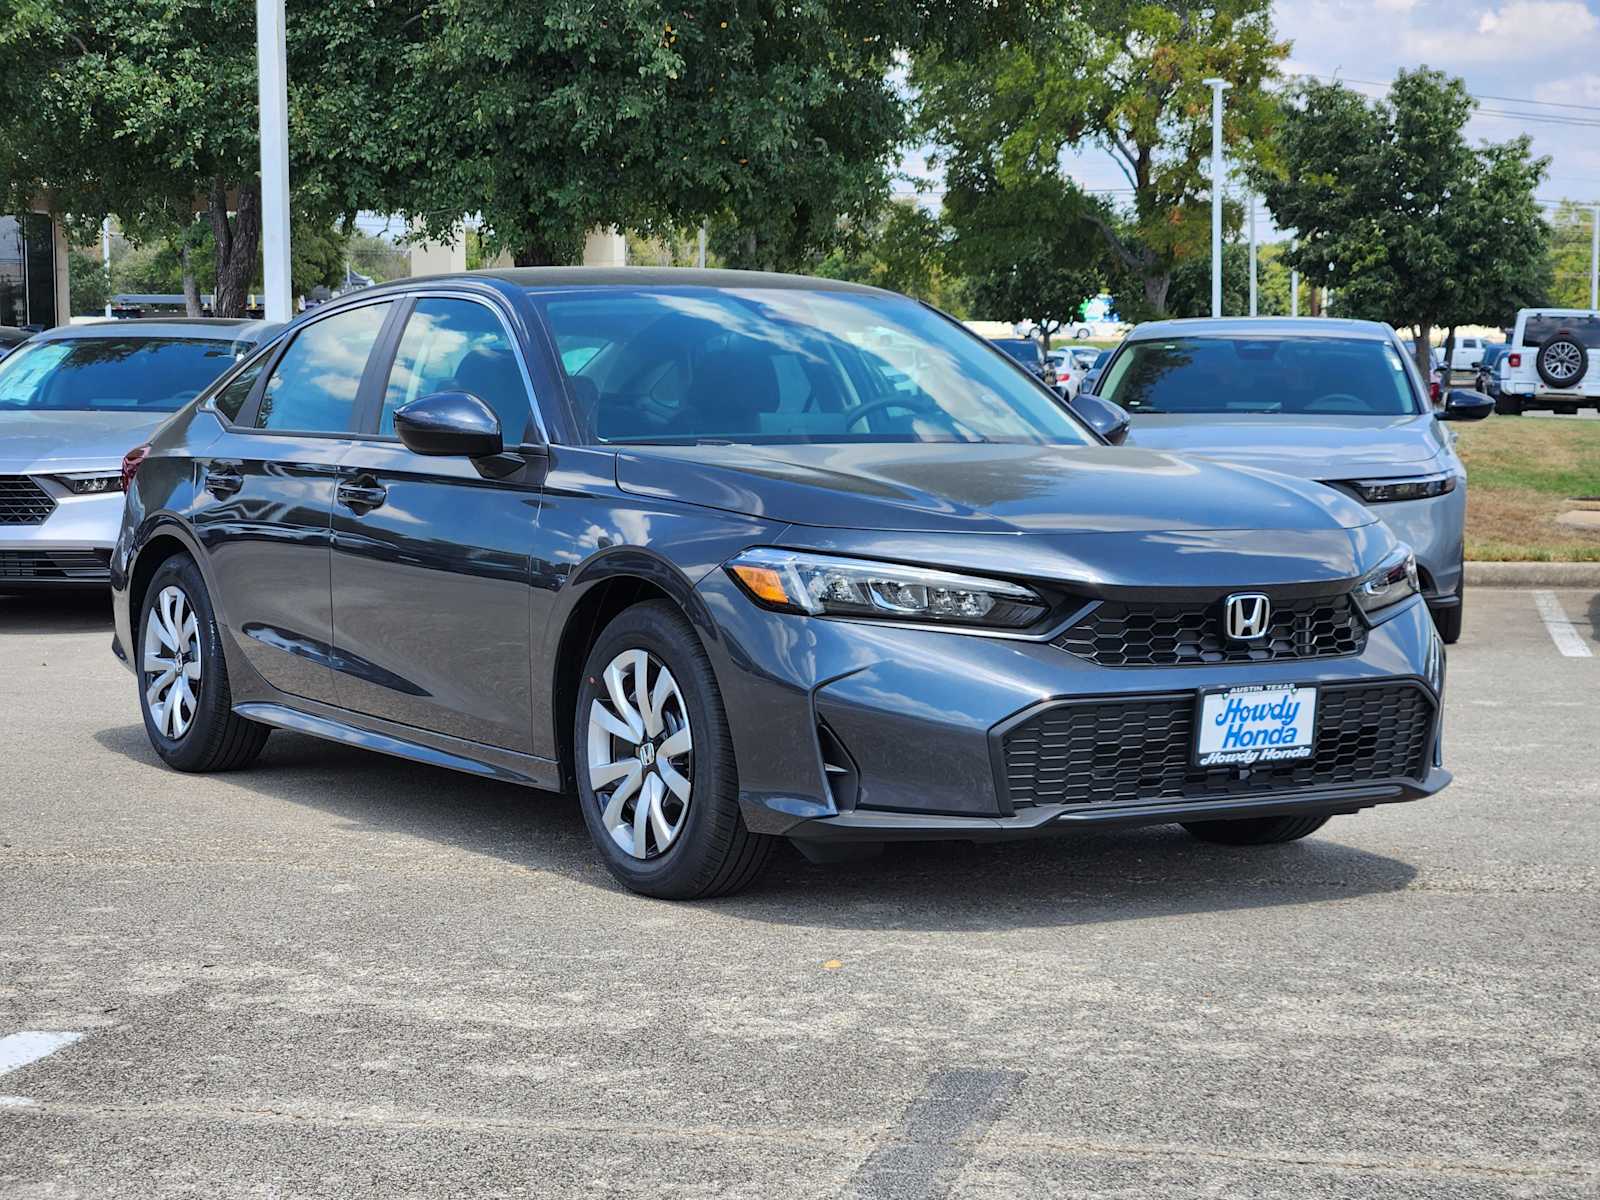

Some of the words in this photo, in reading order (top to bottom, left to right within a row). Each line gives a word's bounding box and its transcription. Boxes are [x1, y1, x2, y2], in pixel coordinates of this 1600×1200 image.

[1230, 686, 1263, 694] AUSTIN
[1266, 683, 1296, 691] TEXAS
[1215, 695, 1301, 726] Howdy
[1222, 723, 1298, 749] Honda
[1200, 750, 1259, 765] Howdy
[1260, 746, 1311, 760] Honda
